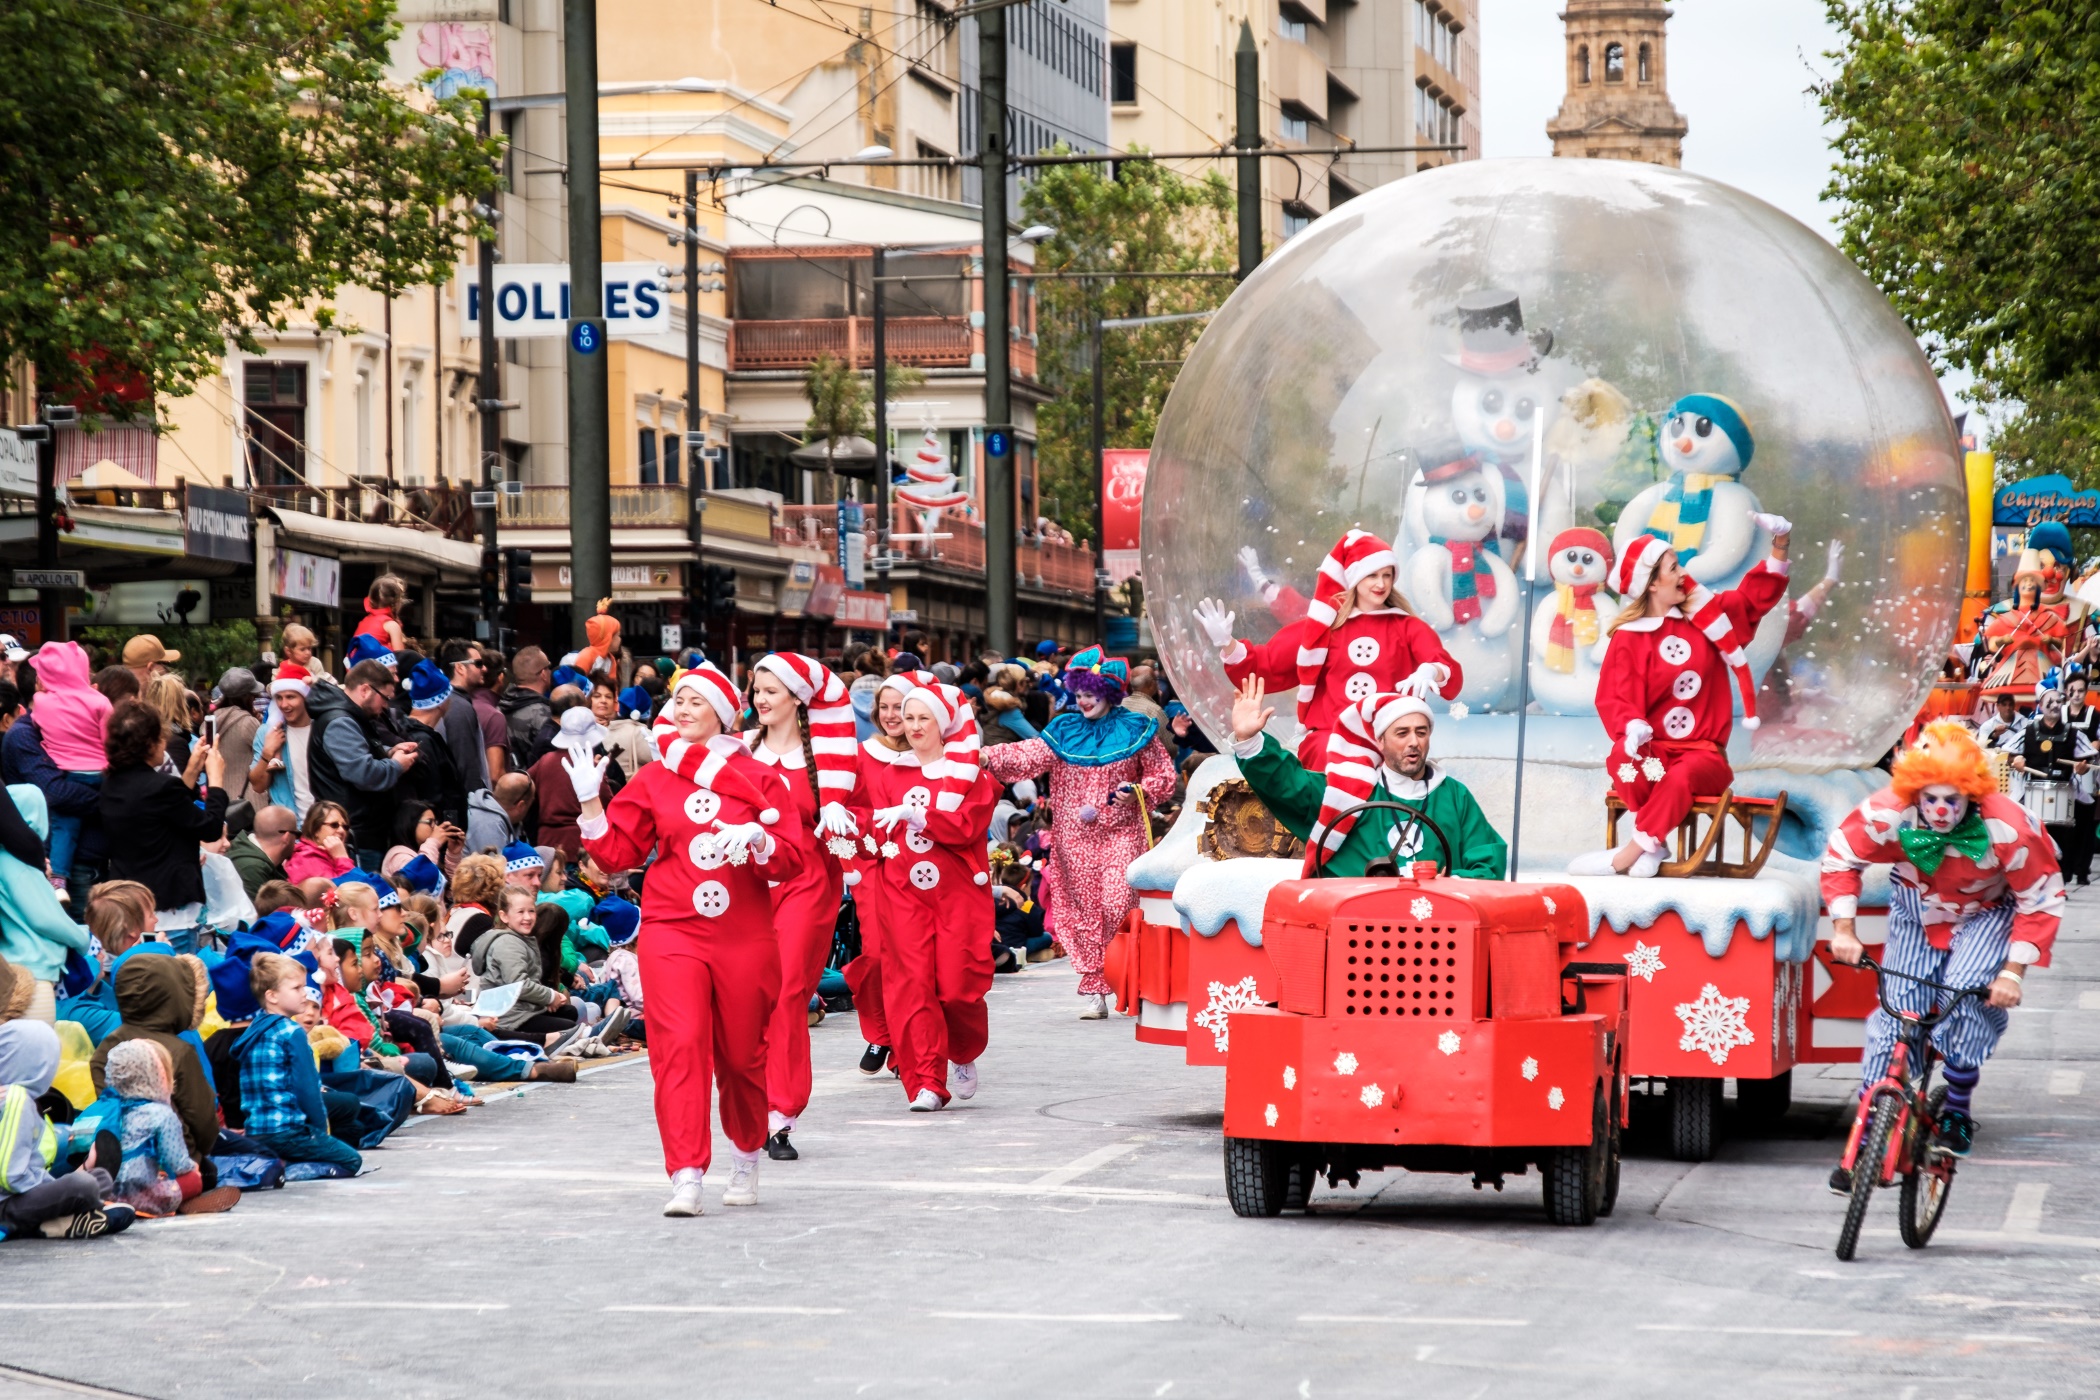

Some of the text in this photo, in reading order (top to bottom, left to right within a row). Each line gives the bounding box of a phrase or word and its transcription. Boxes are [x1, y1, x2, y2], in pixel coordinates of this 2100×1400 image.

[581, 324, 590, 336] G
[579, 336, 592, 347] 10
[993, 434, 1001, 443] G
[1106, 475, 1145, 502] Cit
[2002, 491, 2097, 509] Christmas
[187, 505, 248, 540] PULP FICTION COMICS
[27, 573, 74, 585] APOLLO PL
